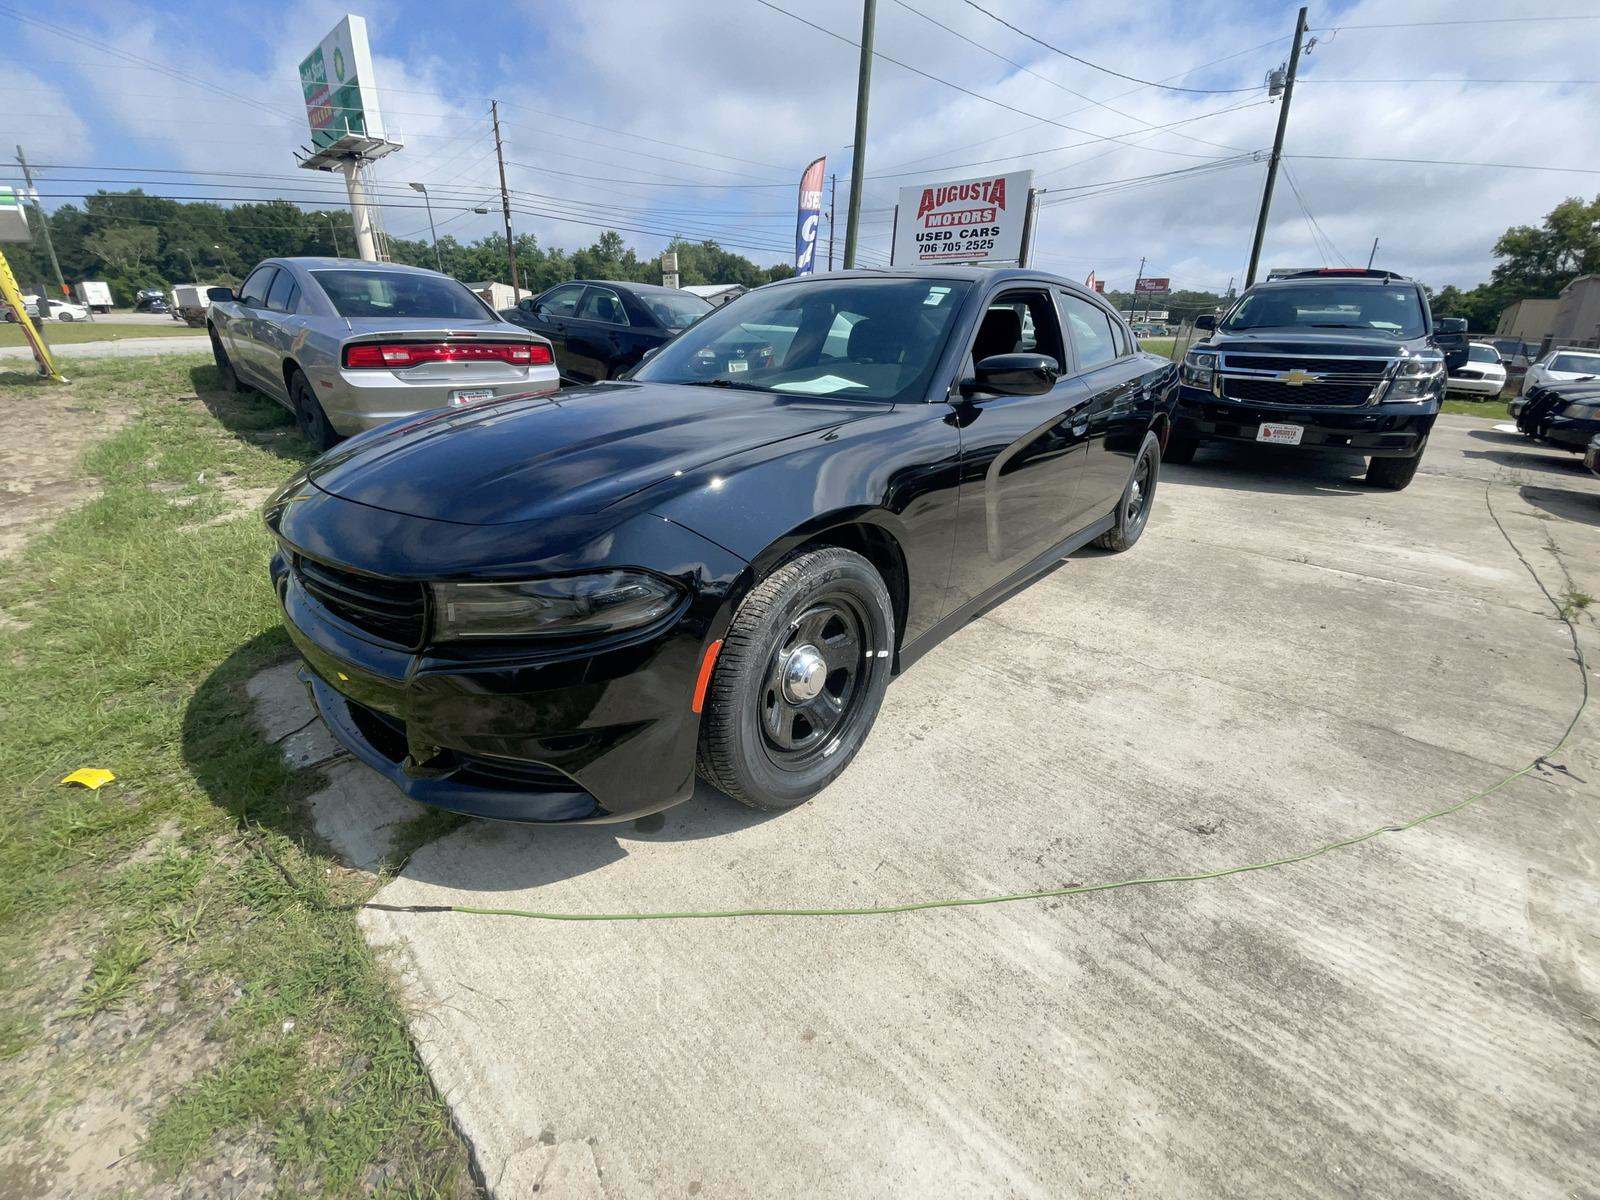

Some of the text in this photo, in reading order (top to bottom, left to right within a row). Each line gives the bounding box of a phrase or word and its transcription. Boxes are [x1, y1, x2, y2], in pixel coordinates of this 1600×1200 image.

[917, 178, 1006, 220] AUGUSTA
[927, 209, 993, 227] MOTORS
[916, 226, 1000, 242] USED CARS
[918, 239, 994, 253] 706 705 2525
